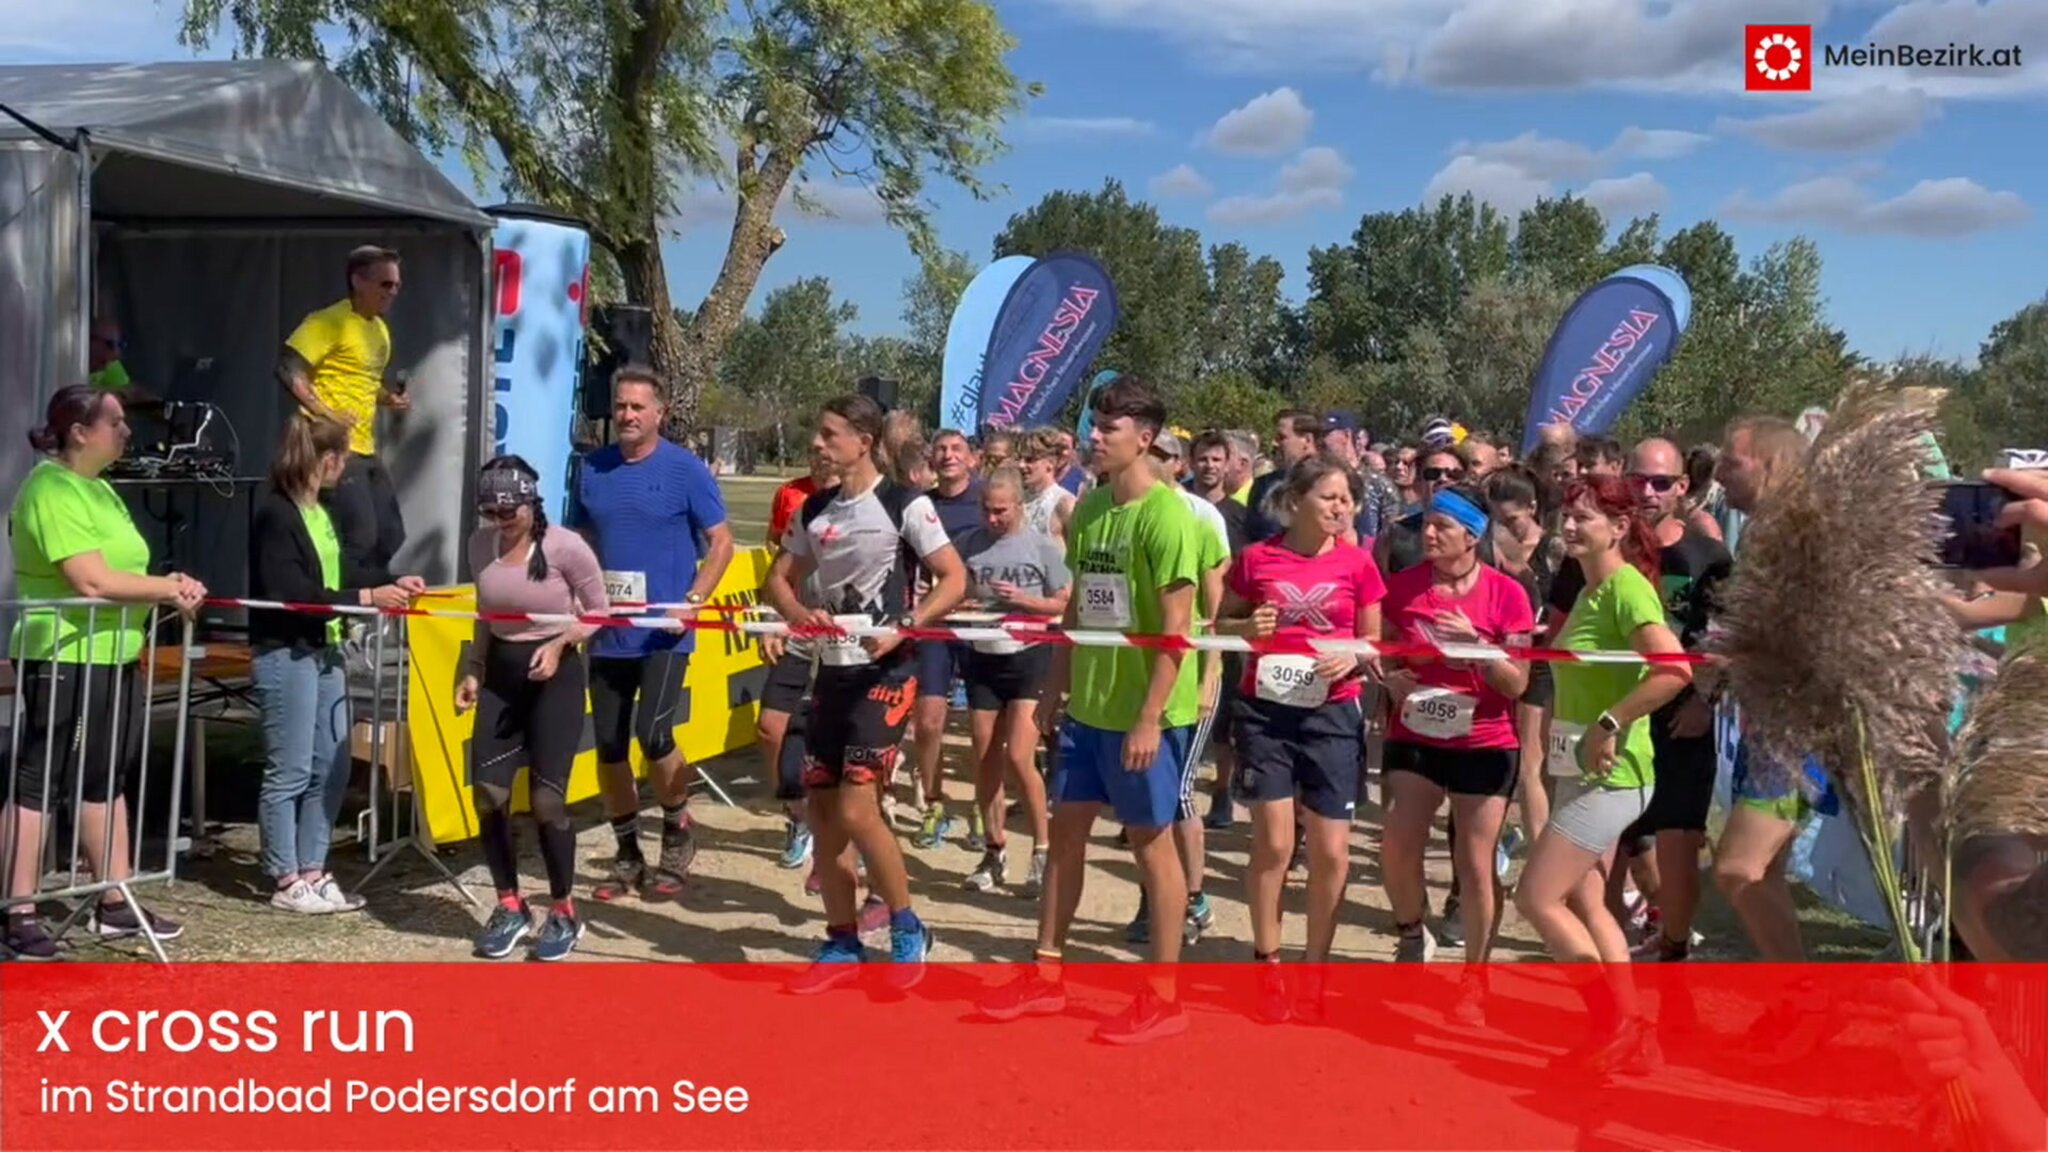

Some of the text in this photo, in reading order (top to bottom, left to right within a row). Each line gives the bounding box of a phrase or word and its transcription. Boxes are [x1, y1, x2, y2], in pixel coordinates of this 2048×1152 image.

[986, 286, 1099, 428] MAGNESIA
[1087, 589, 1115, 605] 3584
[1271, 664, 1315, 687] 3059
[1416, 699, 1458, 721] 3058
